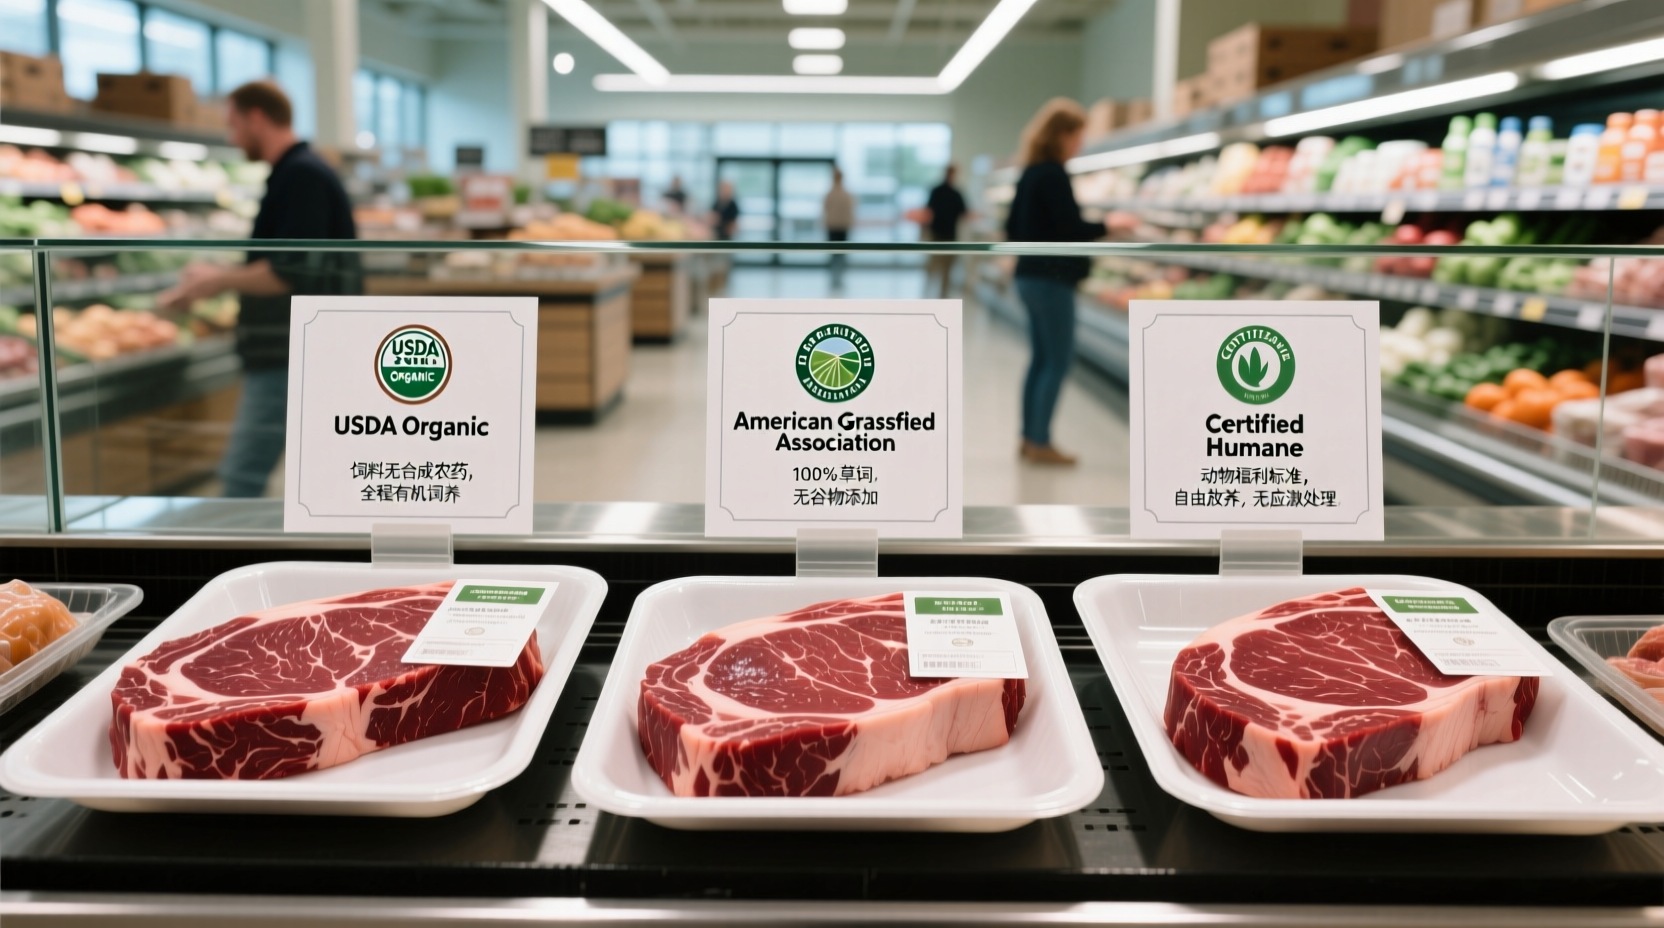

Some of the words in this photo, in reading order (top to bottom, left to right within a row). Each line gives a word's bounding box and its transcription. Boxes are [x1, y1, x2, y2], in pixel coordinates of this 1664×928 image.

[392, 339, 440, 357] USDA
[335, 415, 397, 436] USDA
[402, 415, 489, 441] Organic
[734, 411, 833, 431] American
[838, 411, 935, 431] Grassfied
[1206, 413, 1304, 434] Certified
[775, 433, 896, 452] Association
[1207, 437, 1304, 457] Humane
